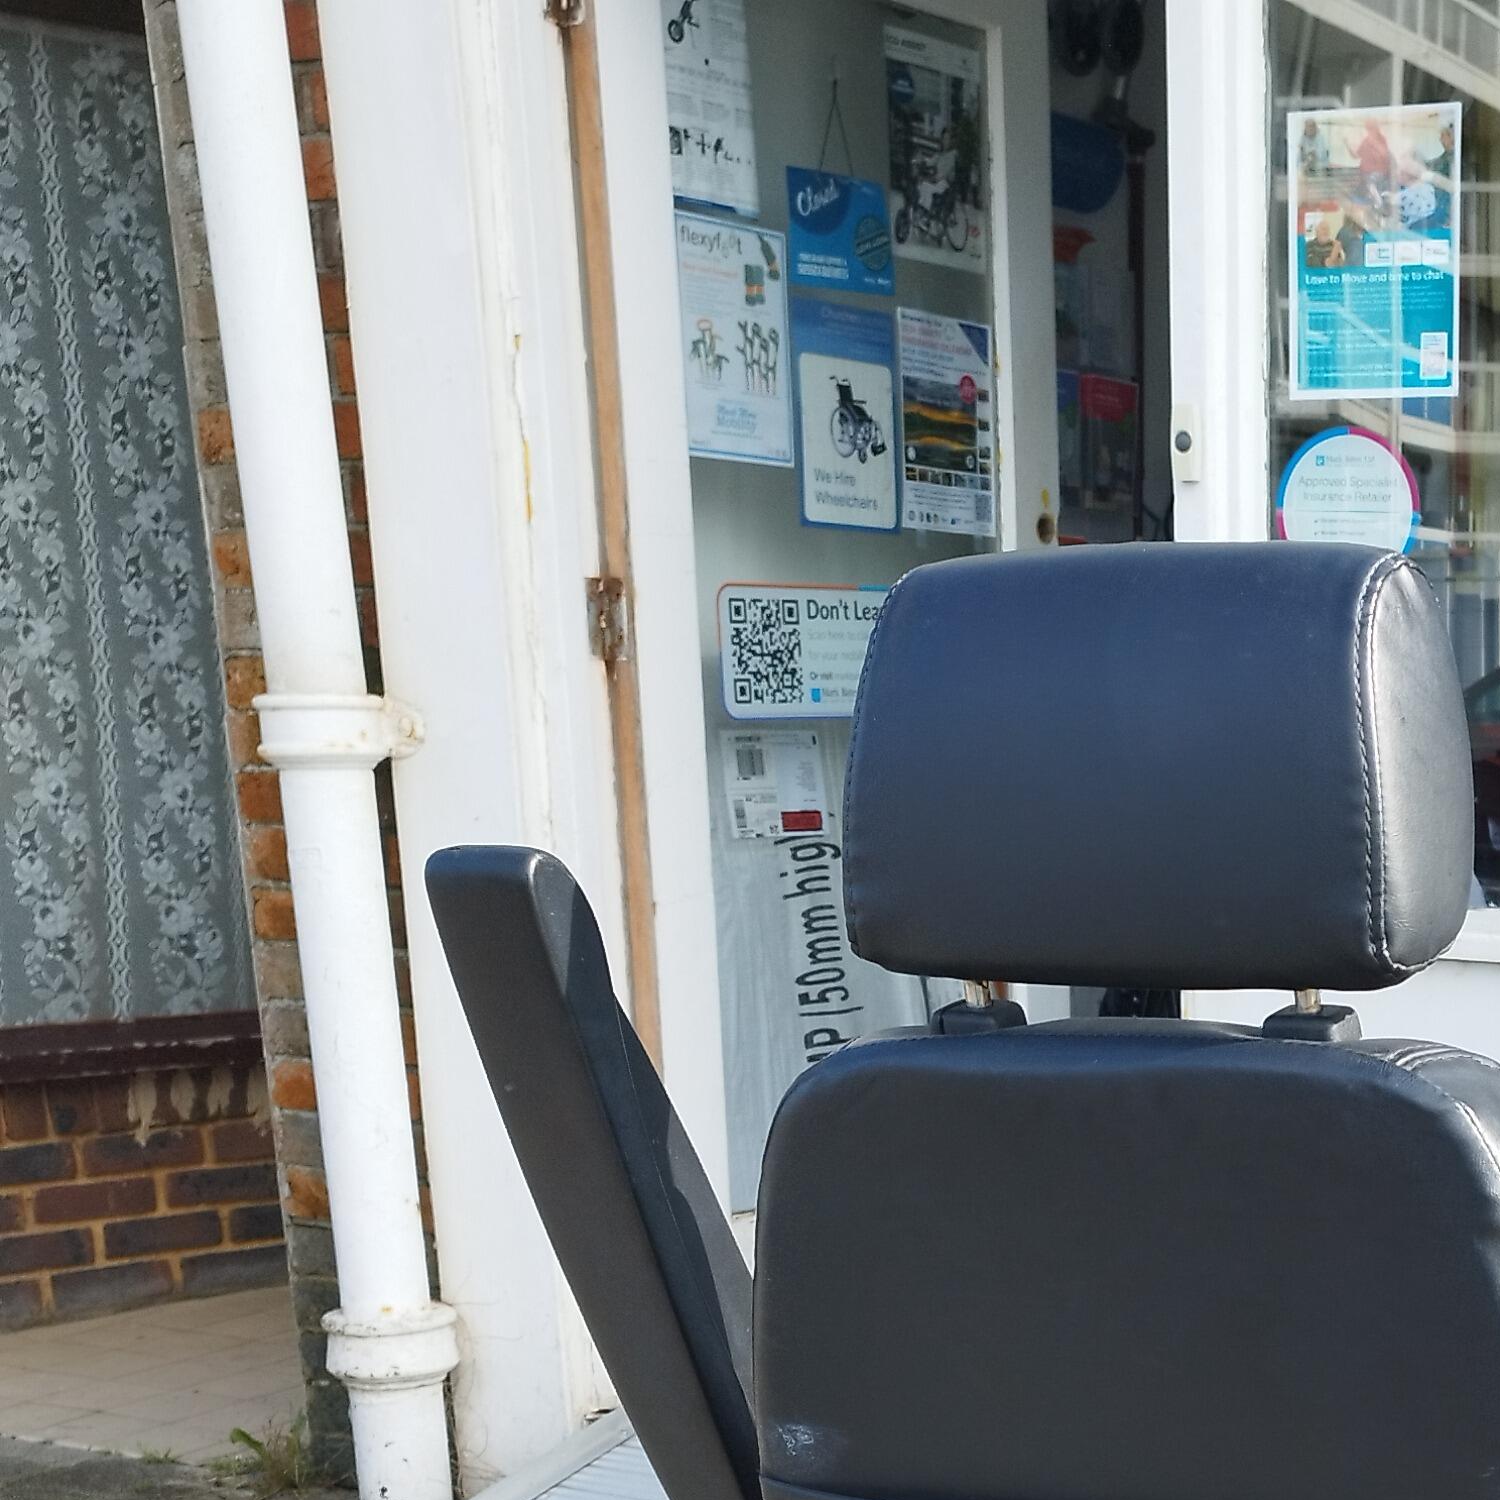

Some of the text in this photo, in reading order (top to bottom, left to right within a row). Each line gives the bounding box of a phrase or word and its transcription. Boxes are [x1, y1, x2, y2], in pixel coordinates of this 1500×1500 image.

[1369, 272, 1387, 282] and
[814, 467, 857, 487] We Hire
[807, 599, 850, 621] Don't
